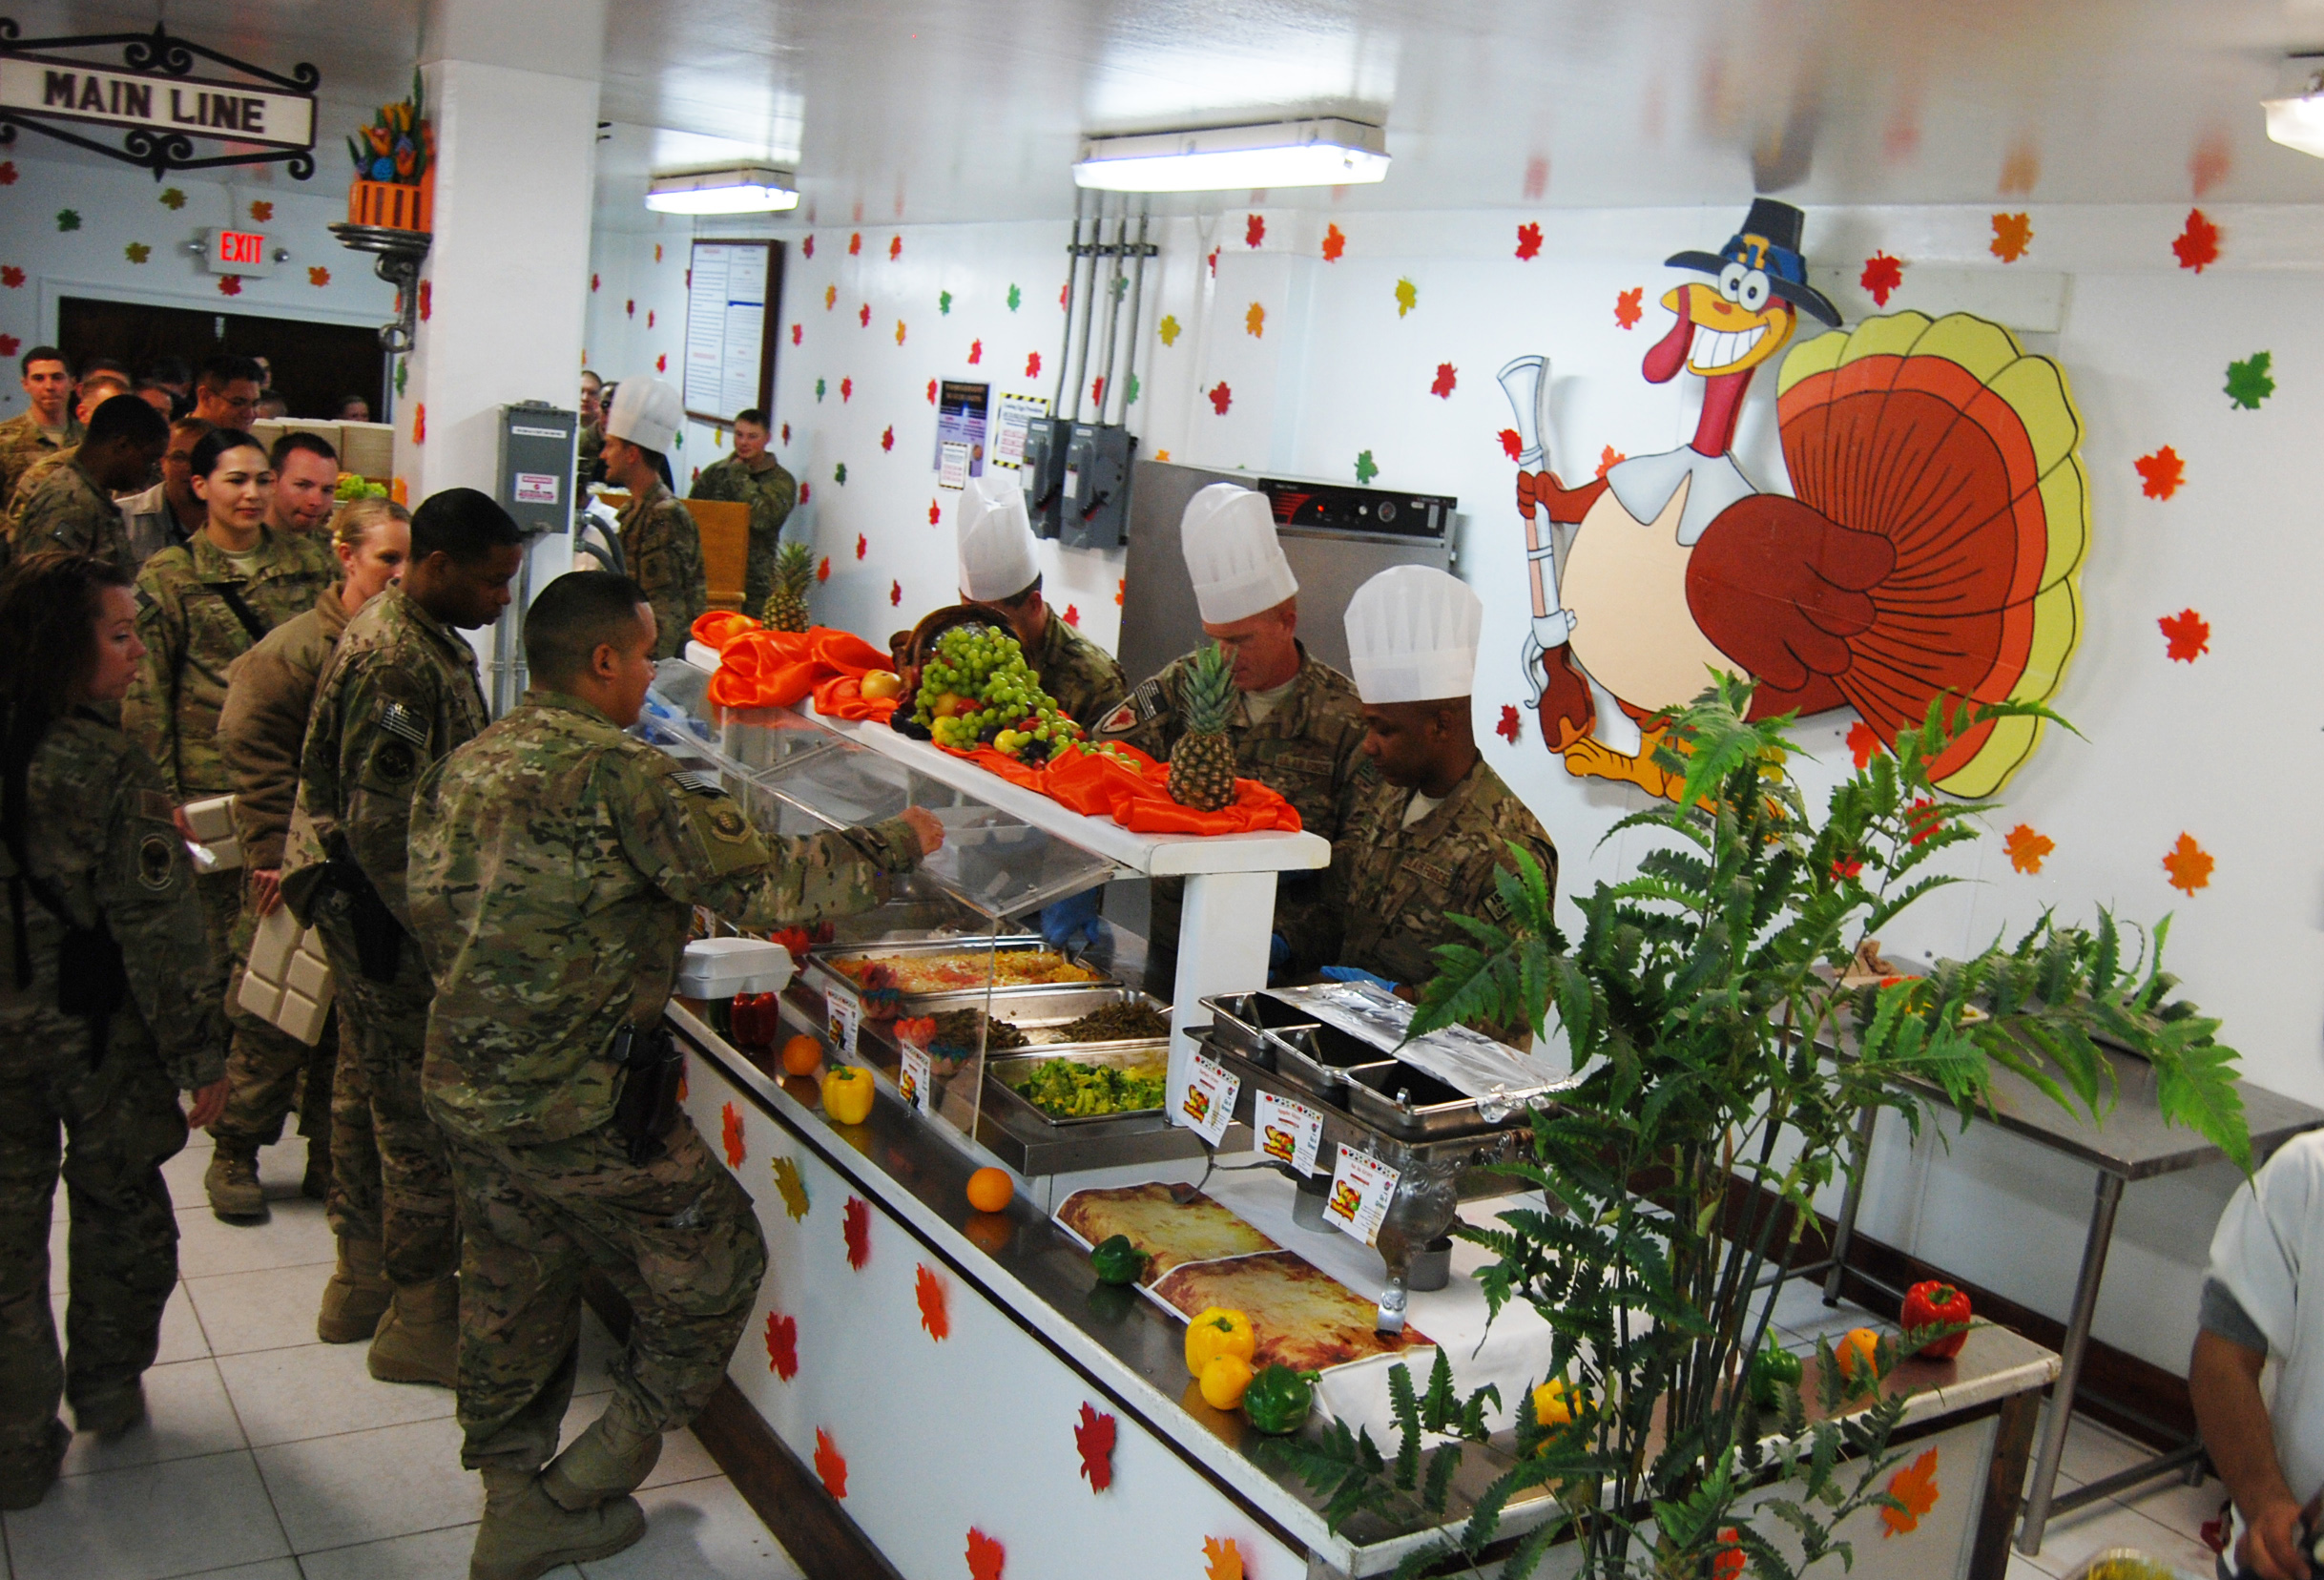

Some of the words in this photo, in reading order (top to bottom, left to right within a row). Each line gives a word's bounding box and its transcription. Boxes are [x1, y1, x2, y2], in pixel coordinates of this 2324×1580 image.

[44, 70, 152, 118] MAIN
[170, 89, 265, 134] LINE
[220, 231, 264, 264] EXIT
